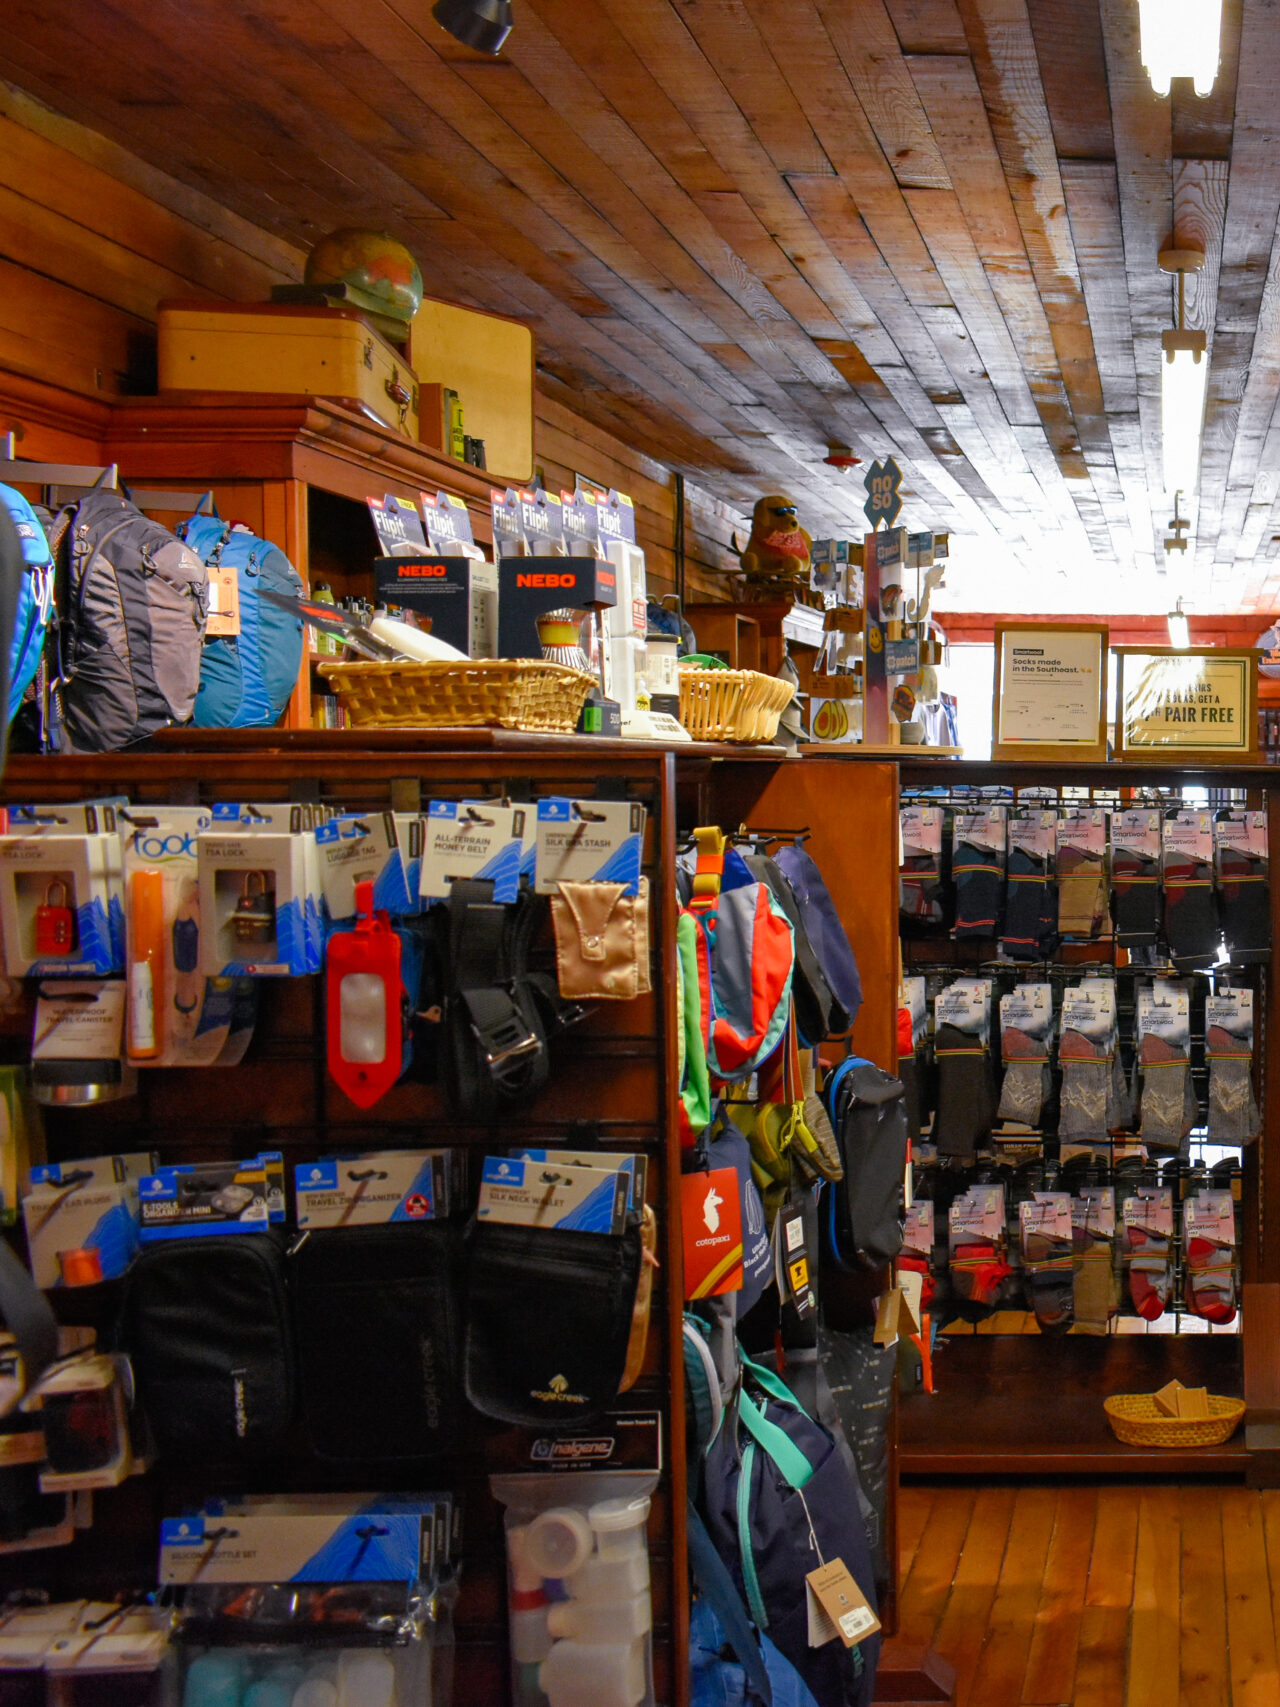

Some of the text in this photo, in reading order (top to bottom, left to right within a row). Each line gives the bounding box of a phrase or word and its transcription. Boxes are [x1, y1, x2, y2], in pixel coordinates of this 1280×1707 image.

[398, 564, 447, 578] NEBO
[516, 573, 577, 589] NEBO
[1198, 695, 1213, 703] GET
[1214, 695, 1220, 703] A
[1165, 706, 1235, 723] PAIR FREE
[435, 834, 491, 846] ALL-TERRAIN
[1112, 830, 1147, 838] Smartwool
[434, 842, 488, 854] MONEY BELT
[545, 838, 564, 847] SILK
[584, 839, 611, 848] STASH
[508, 1194, 529, 1202] NECK
[695, 1234, 731, 1247] cotopaxi
[554, 1441, 609, 1457] nalgene
